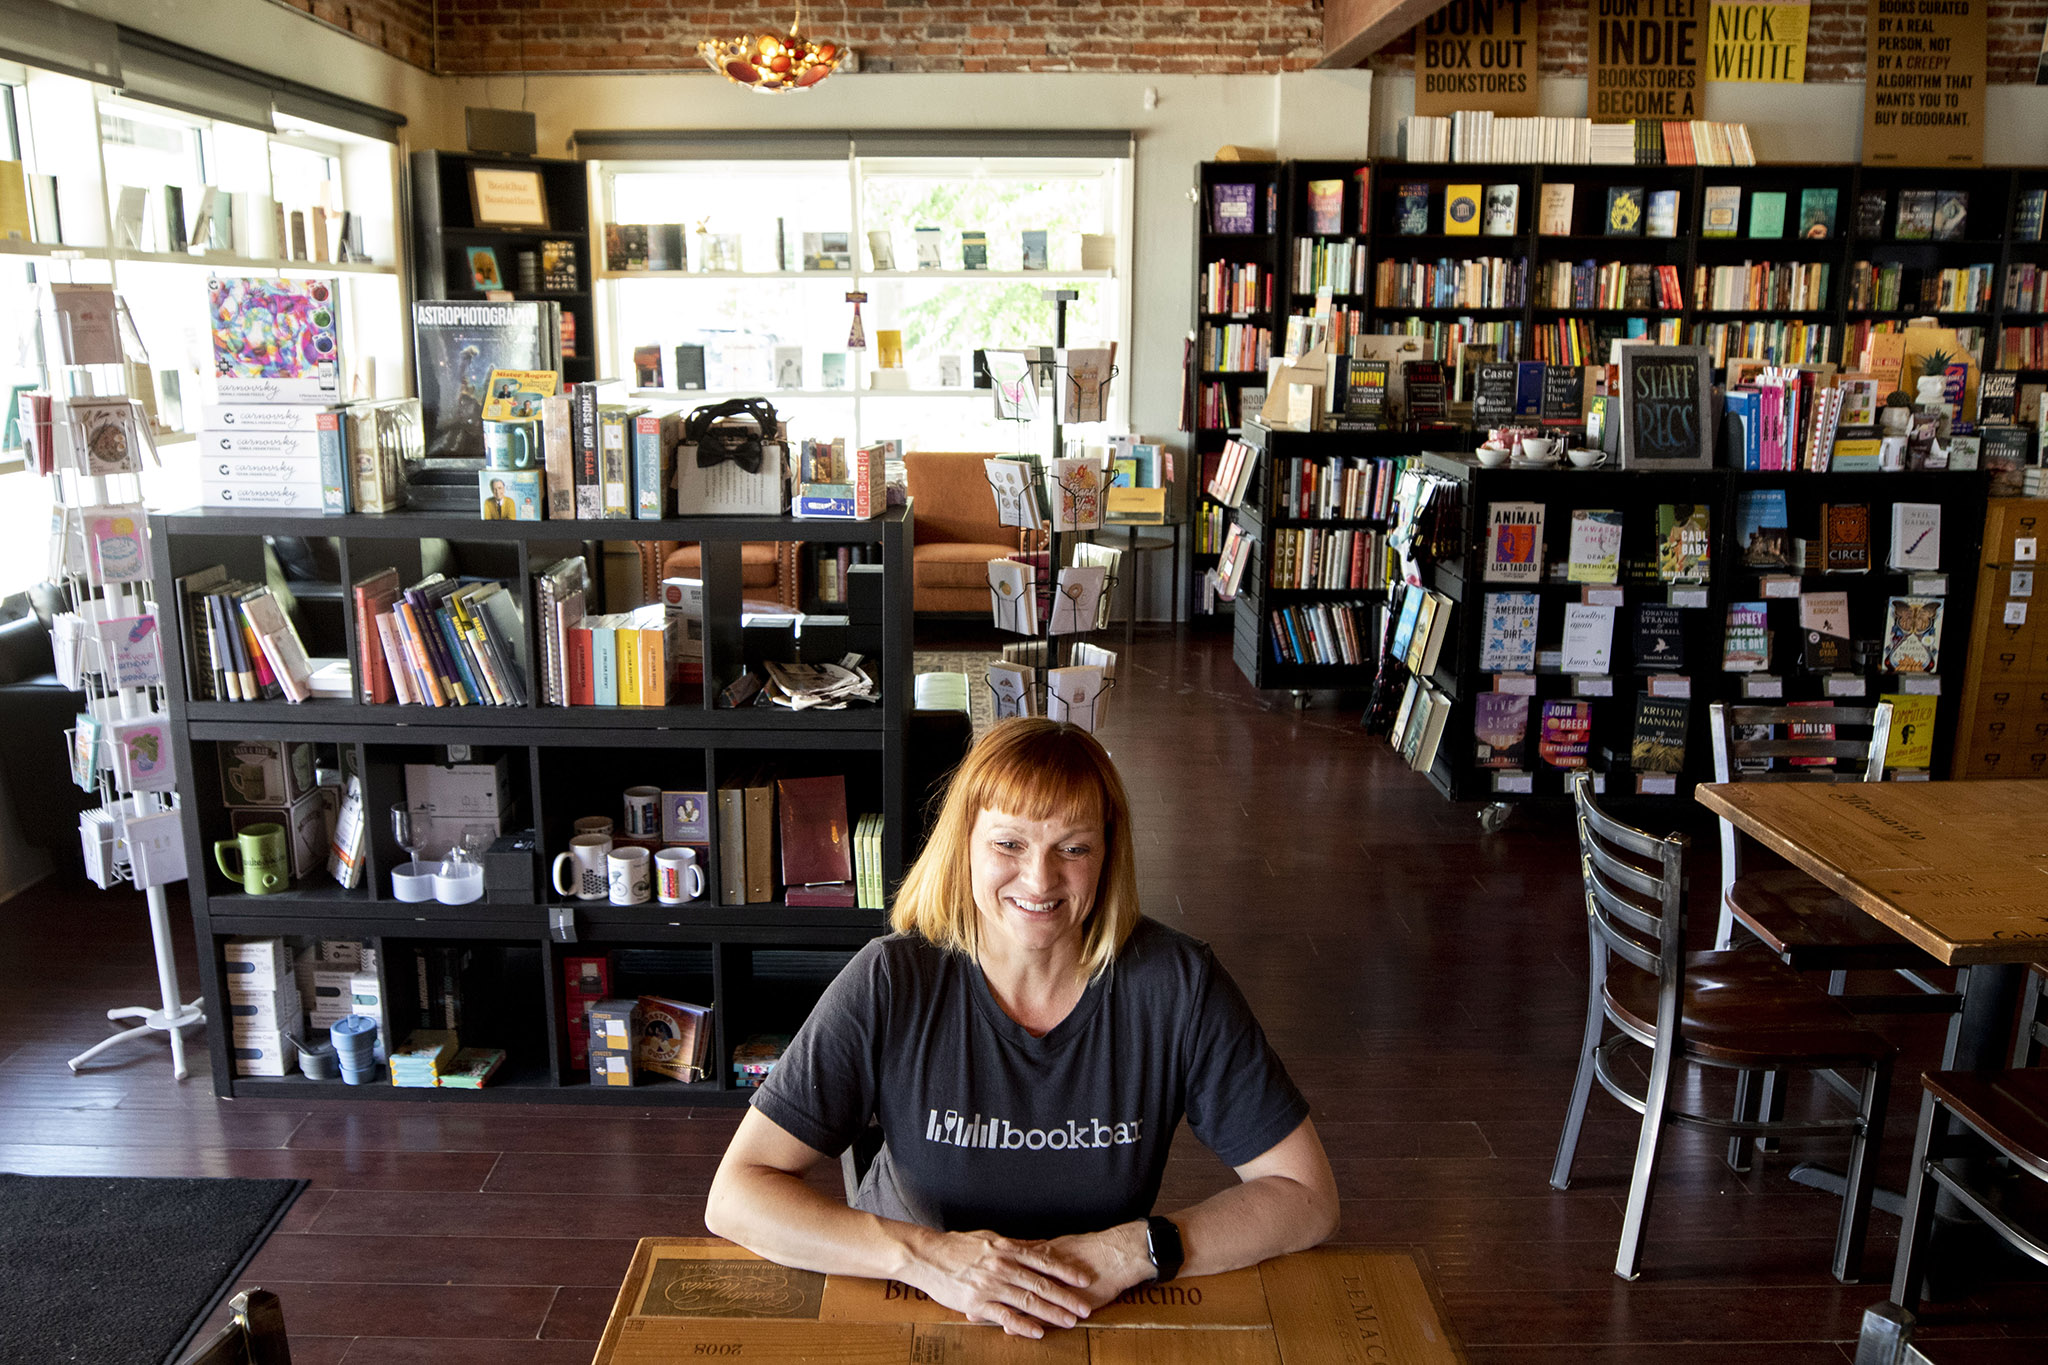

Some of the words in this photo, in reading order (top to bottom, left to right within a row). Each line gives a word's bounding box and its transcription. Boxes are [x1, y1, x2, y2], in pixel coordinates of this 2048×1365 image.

[1879, 1, 1915, 13] BOOKS
[1919, 1, 1969, 15] CURATED
[1716, 5, 1776, 41] NICK
[1878, 18, 1892, 32] BY
[1897, 19, 1903, 32] A
[1907, 19, 1935, 33] REAL
[1599, 20, 1697, 66] INDIE
[1878, 37, 1926, 53] PERSON,
[1929, 38, 1952, 51] NOT
[1426, 40, 1471, 68] BOX
[1480, 40, 1527, 68] OUT
[1714, 43, 1798, 79] WHITE
[1877, 55, 1892, 69] BY
[1896, 56, 1902, 69] A
[1907, 56, 1951, 70] CREEPY
[1426, 73, 1527, 92] BOOKSTORES
[1598, 69, 1696, 88] BOOKSTORES
[1877, 74, 1941, 88] ALGORITHM
[1946, 75, 1973, 89] THAT
[1598, 91, 1676, 114] BECOME
[1683, 92, 1694, 114] A
[1876, 93, 1915, 107] WANTS
[1919, 93, 1941, 107] YOU
[1945, 94, 1958, 107] TO
[1875, 111, 1897, 125] BUY
[1901, 112, 1970, 126] DEODORANT.
[418, 306, 538, 326] ASTROPHOTOGRAPHY
[1483, 369, 1513, 379] Caste
[1637, 364, 1694, 400] STAFF
[218, 381, 280, 400] carnovsky
[582, 393, 593, 424] THOSE
[240, 409, 302, 429] carnovsky
[1636, 402, 1695, 449] RECS
[583, 426, 594, 448] WHO
[237, 435, 299, 454] carnovsky
[235, 462, 296, 480] carnovsky
[238, 486, 298, 505] carnovsky
[1495, 511, 1542, 525] ANIMAL
[1905, 519, 1936, 527] GAIMAN
[1681, 530, 1708, 543] CAUL
[1681, 543, 1708, 555] BABY
[1829, 550, 1865, 561] CIRCE
[1286, 534, 1295, 582] ROTH
[1491, 563, 1508, 572] LISA
[1510, 563, 1537, 572] TADDEO
[1496, 606, 1534, 615] AMERICAN
[1571, 610, 1607, 621] Goodbye,
[1569, 622, 1593, 630] again
[1641, 616, 1679, 624] STRANGE
[452, 616, 466, 640] MARCH
[471, 617, 487, 641] MARCH
[1503, 630, 1522, 640] DIRT
[1652, 628, 1680, 636] NORRELL
[1728, 628, 1763, 636] WHEN
[1748, 638, 1764, 649] DRY
[1567, 658, 1590, 667] Jonny
[1549, 705, 1572, 716] JOHN
[1643, 706, 1682, 716] KRISTIN
[1893, 708, 1932, 724] OMMITTED
[1561, 719, 1588, 728] GREEN
[1639, 717, 1684, 728] HANNAH
[1793, 723, 1832, 733] WINTER
[1568, 733, 1578, 741] THE
[1660, 736, 1684, 745] WINDS
[1545, 745, 1587, 753] ANTHROPOCENE
[999, 1118, 1144, 1150] bookbar
[694, 1343, 743, 1355] 2008
